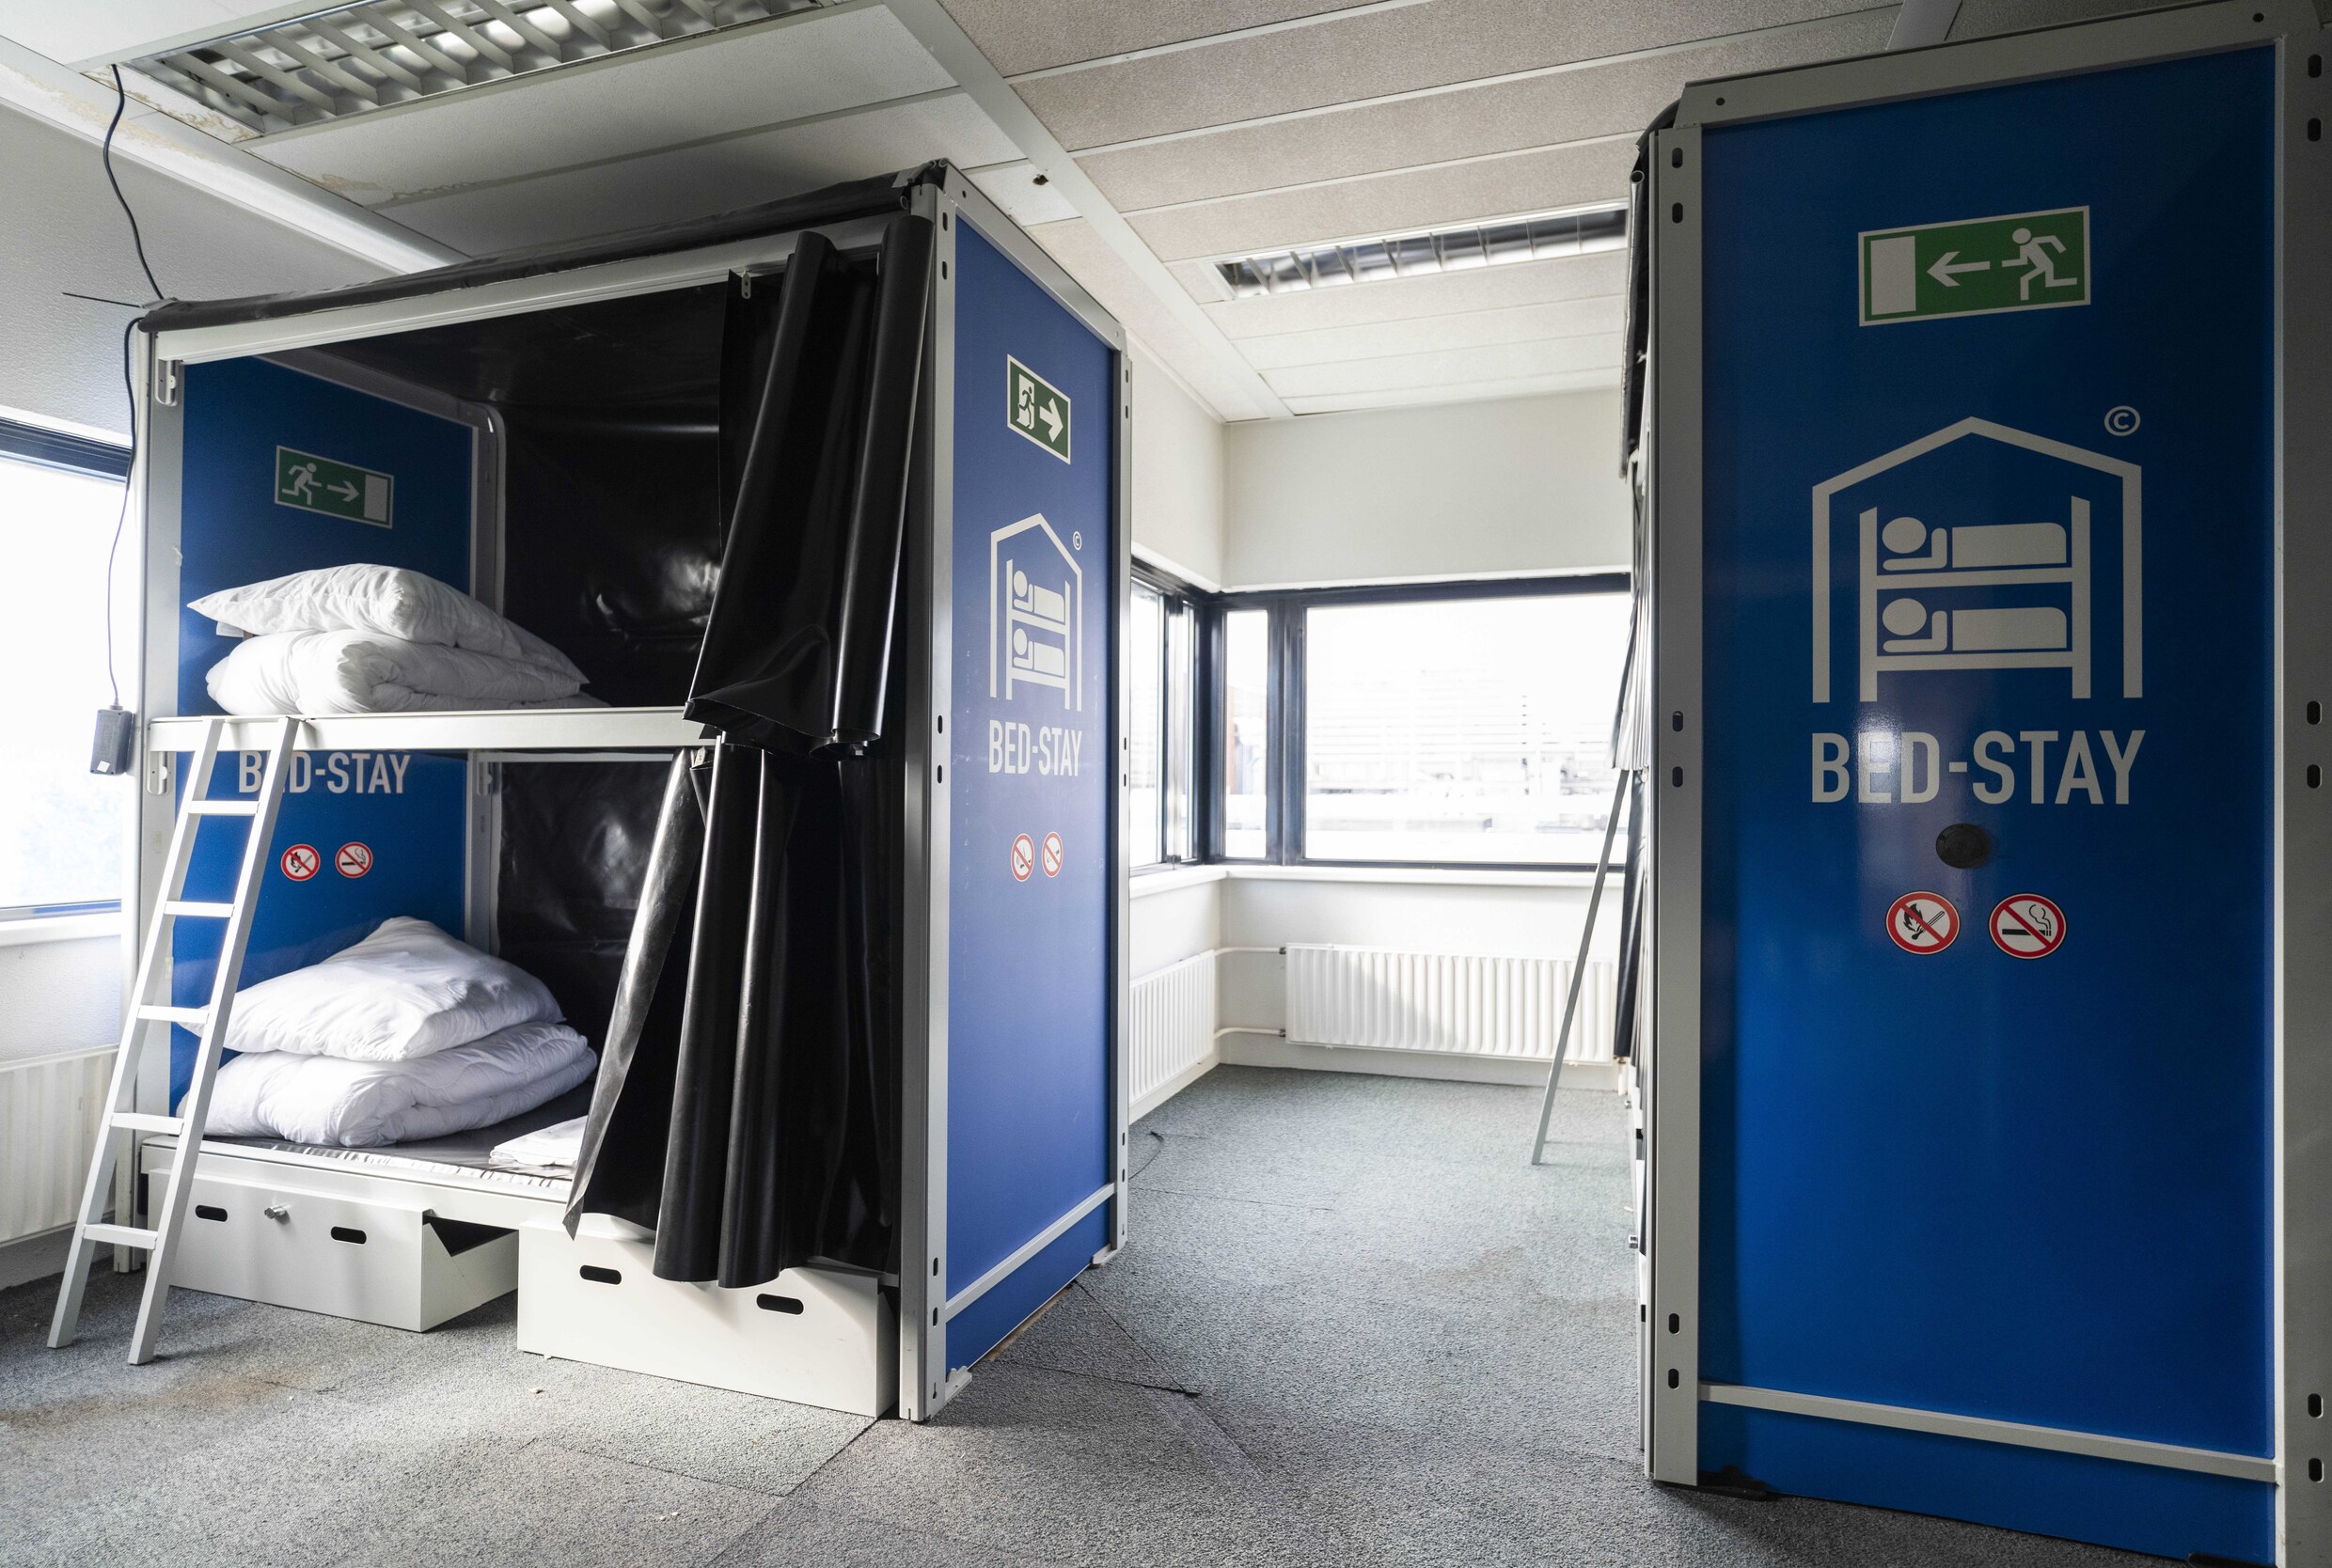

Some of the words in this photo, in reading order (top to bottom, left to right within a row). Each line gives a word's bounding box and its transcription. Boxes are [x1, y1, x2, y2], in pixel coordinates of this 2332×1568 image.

[239, 751, 411, 794] BD-STAY
[989, 719, 1082, 776] BED-STAY
[1811, 729, 2146, 805] BED-STAY
